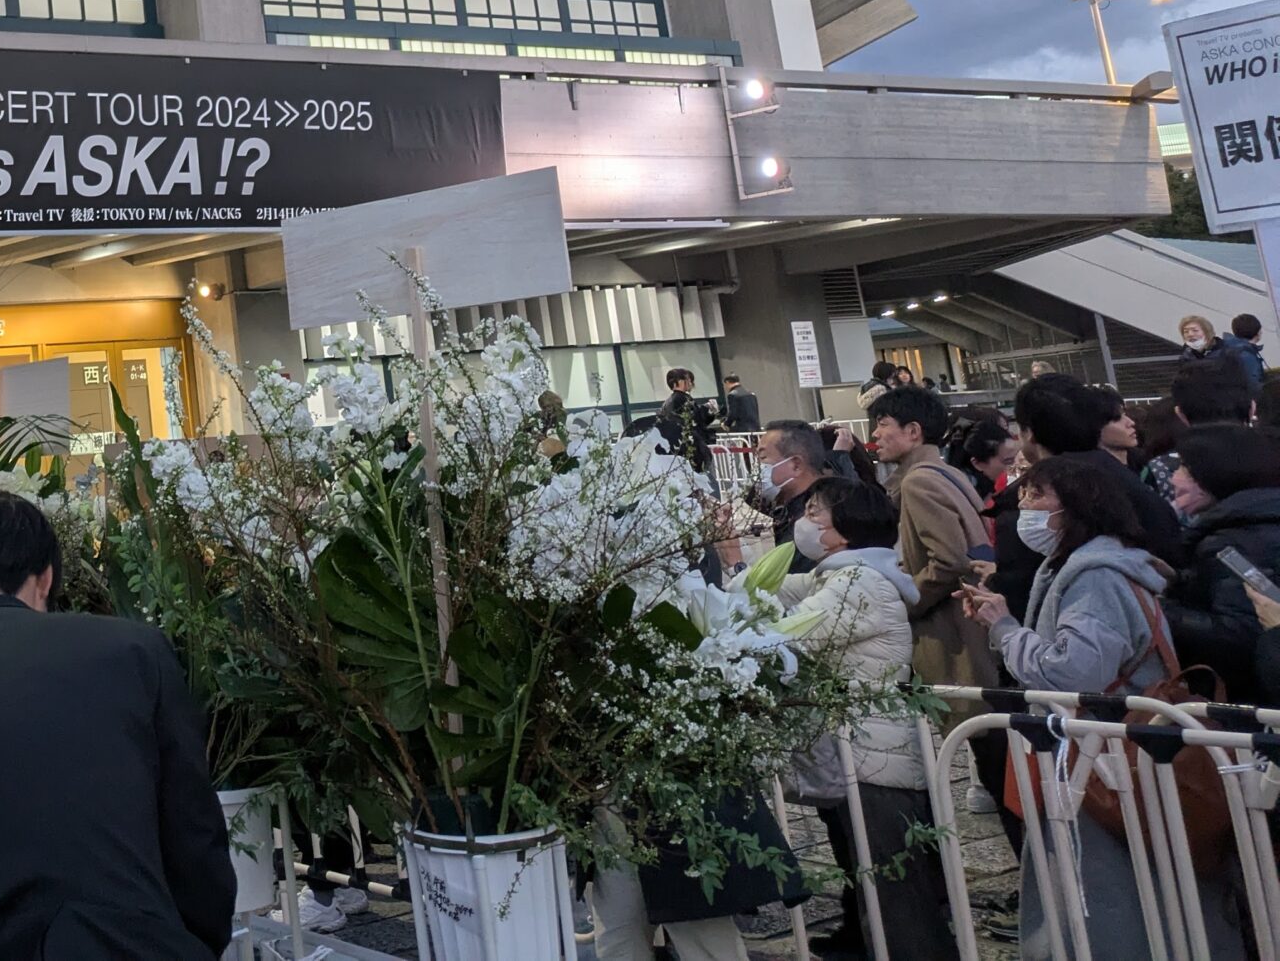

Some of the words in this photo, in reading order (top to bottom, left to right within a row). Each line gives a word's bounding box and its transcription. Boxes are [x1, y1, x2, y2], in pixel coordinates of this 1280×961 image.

[1201, 44, 1239, 62] ASKA
[1204, 55, 1267, 86] WHO
[86, 93, 184, 126] TOUR
[20, 135, 202, 196] ASKA
[46, 208, 65, 221] TV
[148, 207, 167, 220] FM
[175, 207, 193, 220] tvk
[201, 207, 242, 220] NACK5
